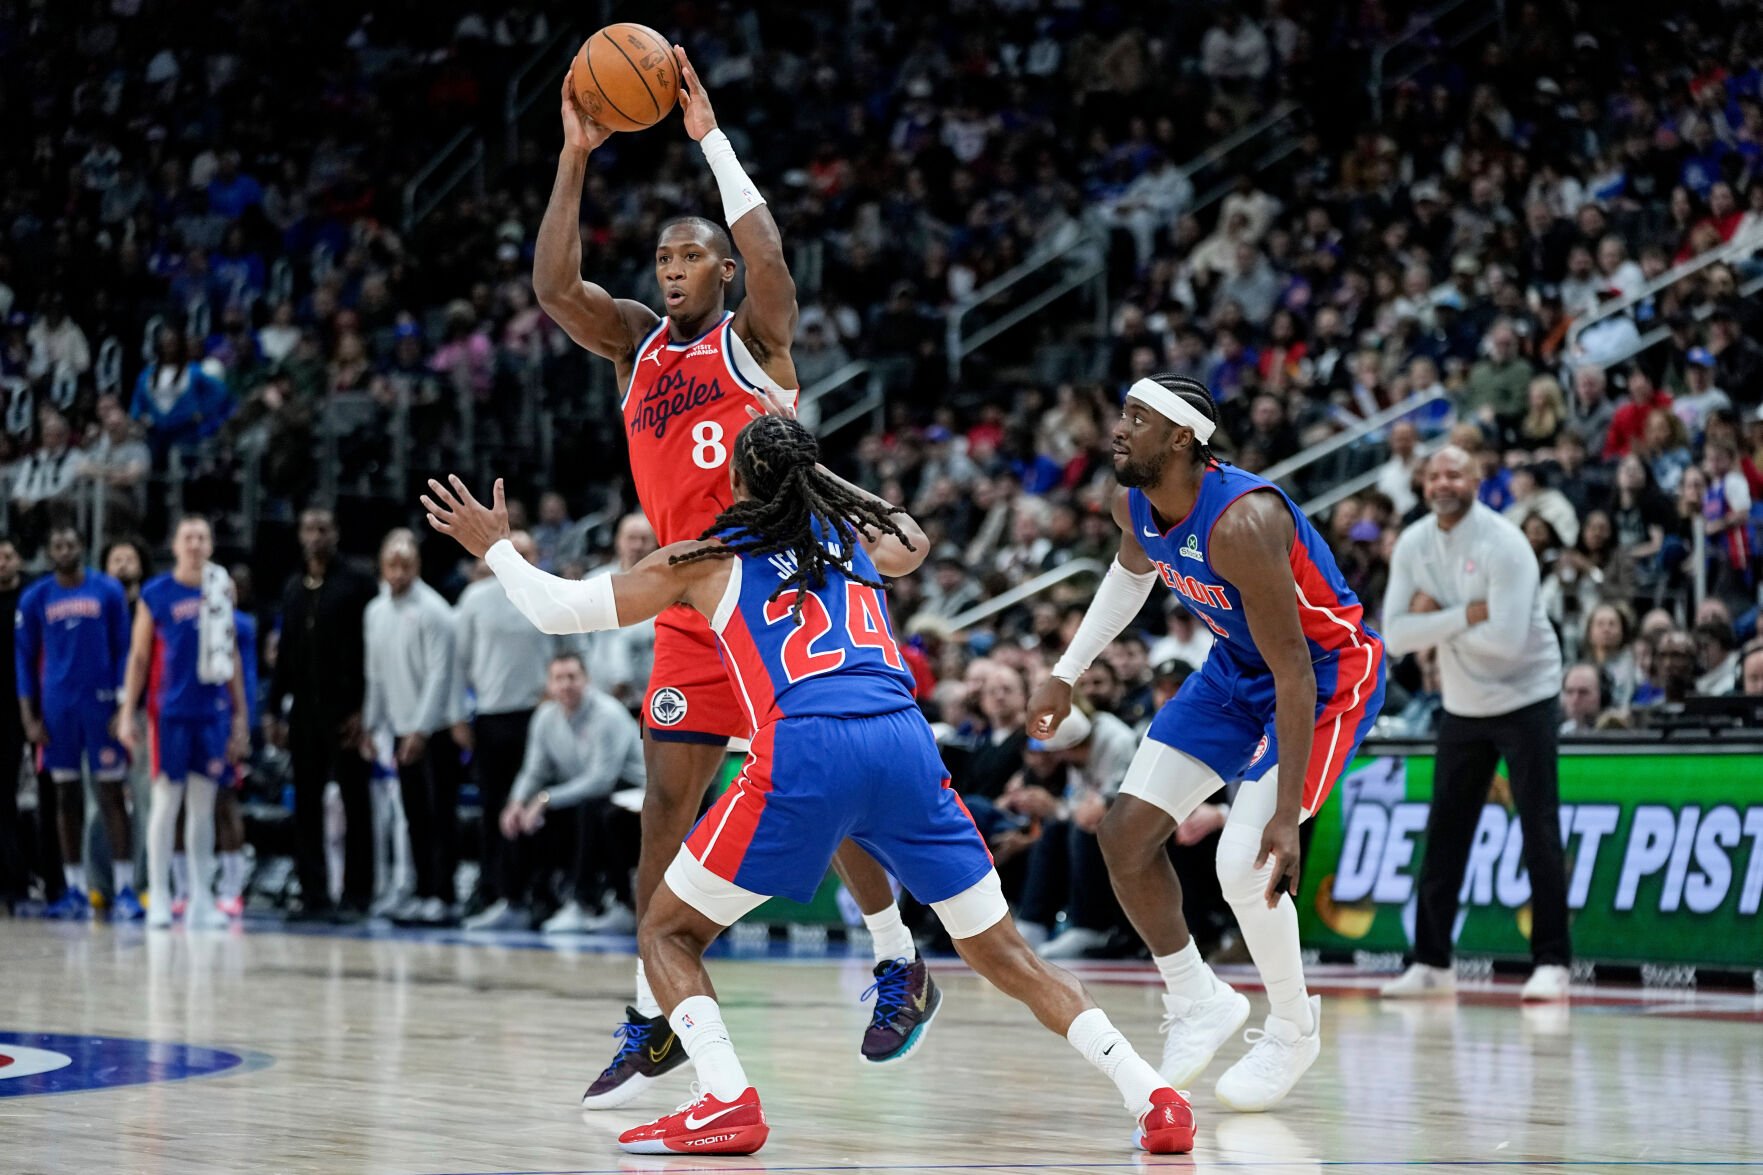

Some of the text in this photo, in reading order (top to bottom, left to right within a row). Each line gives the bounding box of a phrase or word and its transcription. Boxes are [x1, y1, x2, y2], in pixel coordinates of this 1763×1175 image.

[686, 348, 719, 359] RWANDA
[630, 375, 725, 439] Angeles
[643, 369, 687, 403] Los
[691, 420, 727, 469] 8
[762, 580, 905, 684] 24
[1332, 803, 1621, 910] DEROT
